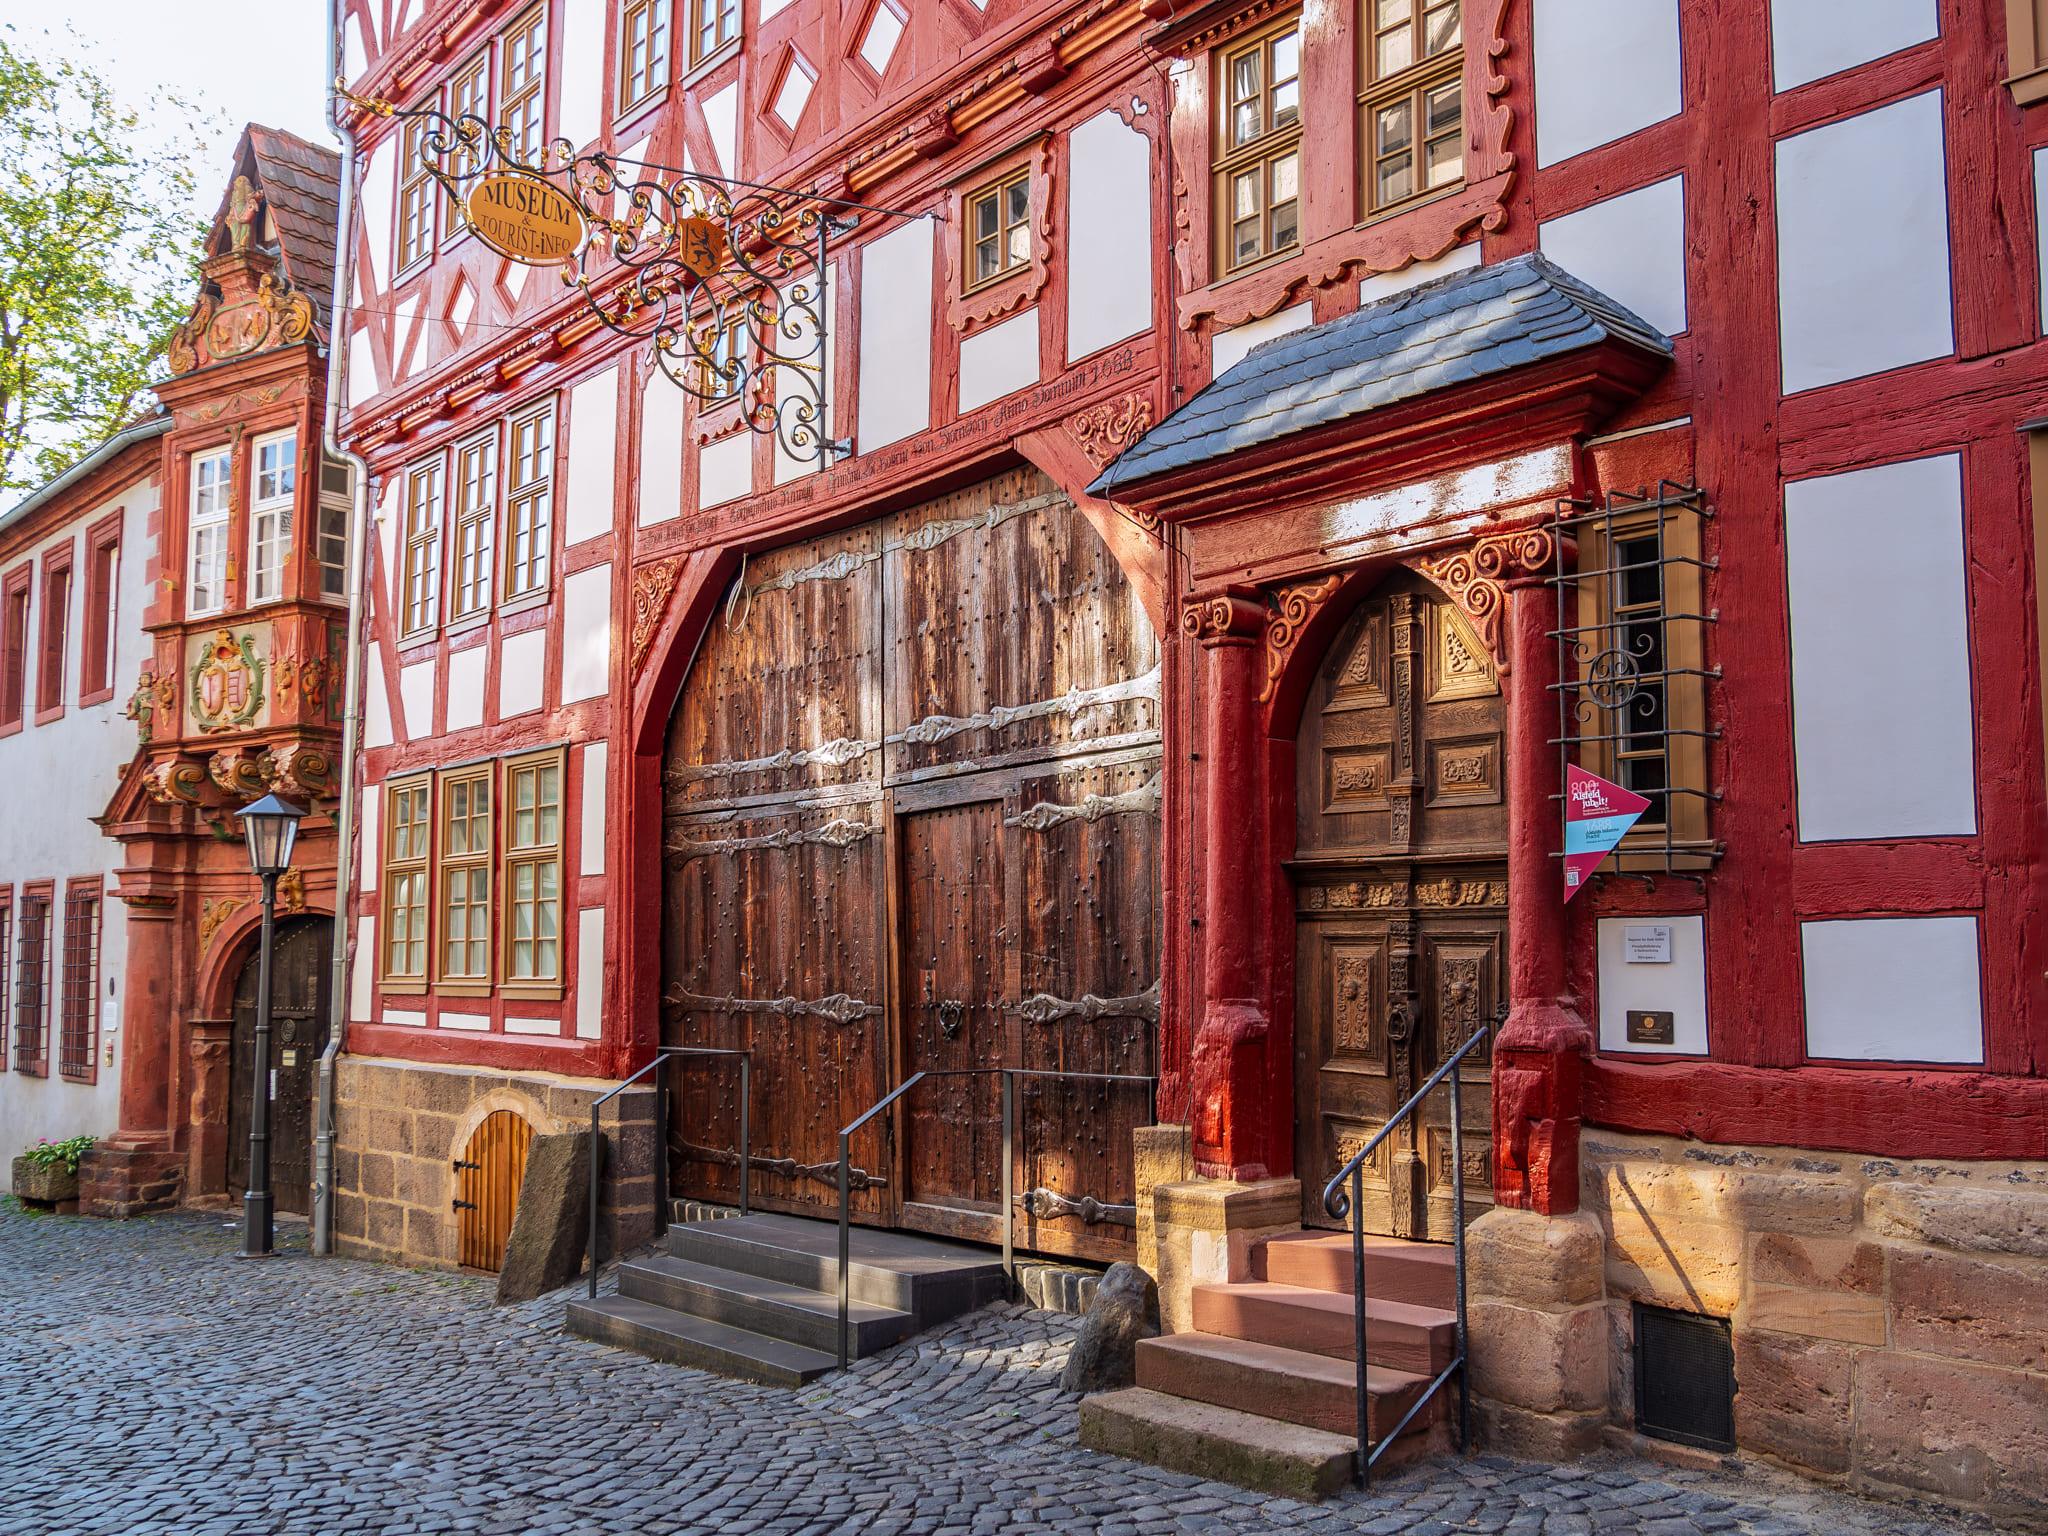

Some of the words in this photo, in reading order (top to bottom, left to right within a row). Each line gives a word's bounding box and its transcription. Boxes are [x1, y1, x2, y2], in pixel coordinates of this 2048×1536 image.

[484, 181, 571, 226] MUSEUM
[521, 215, 531, 226] &
[1571, 779, 1597, 795] 800
[1572, 788, 1601, 801] Alsfeld
